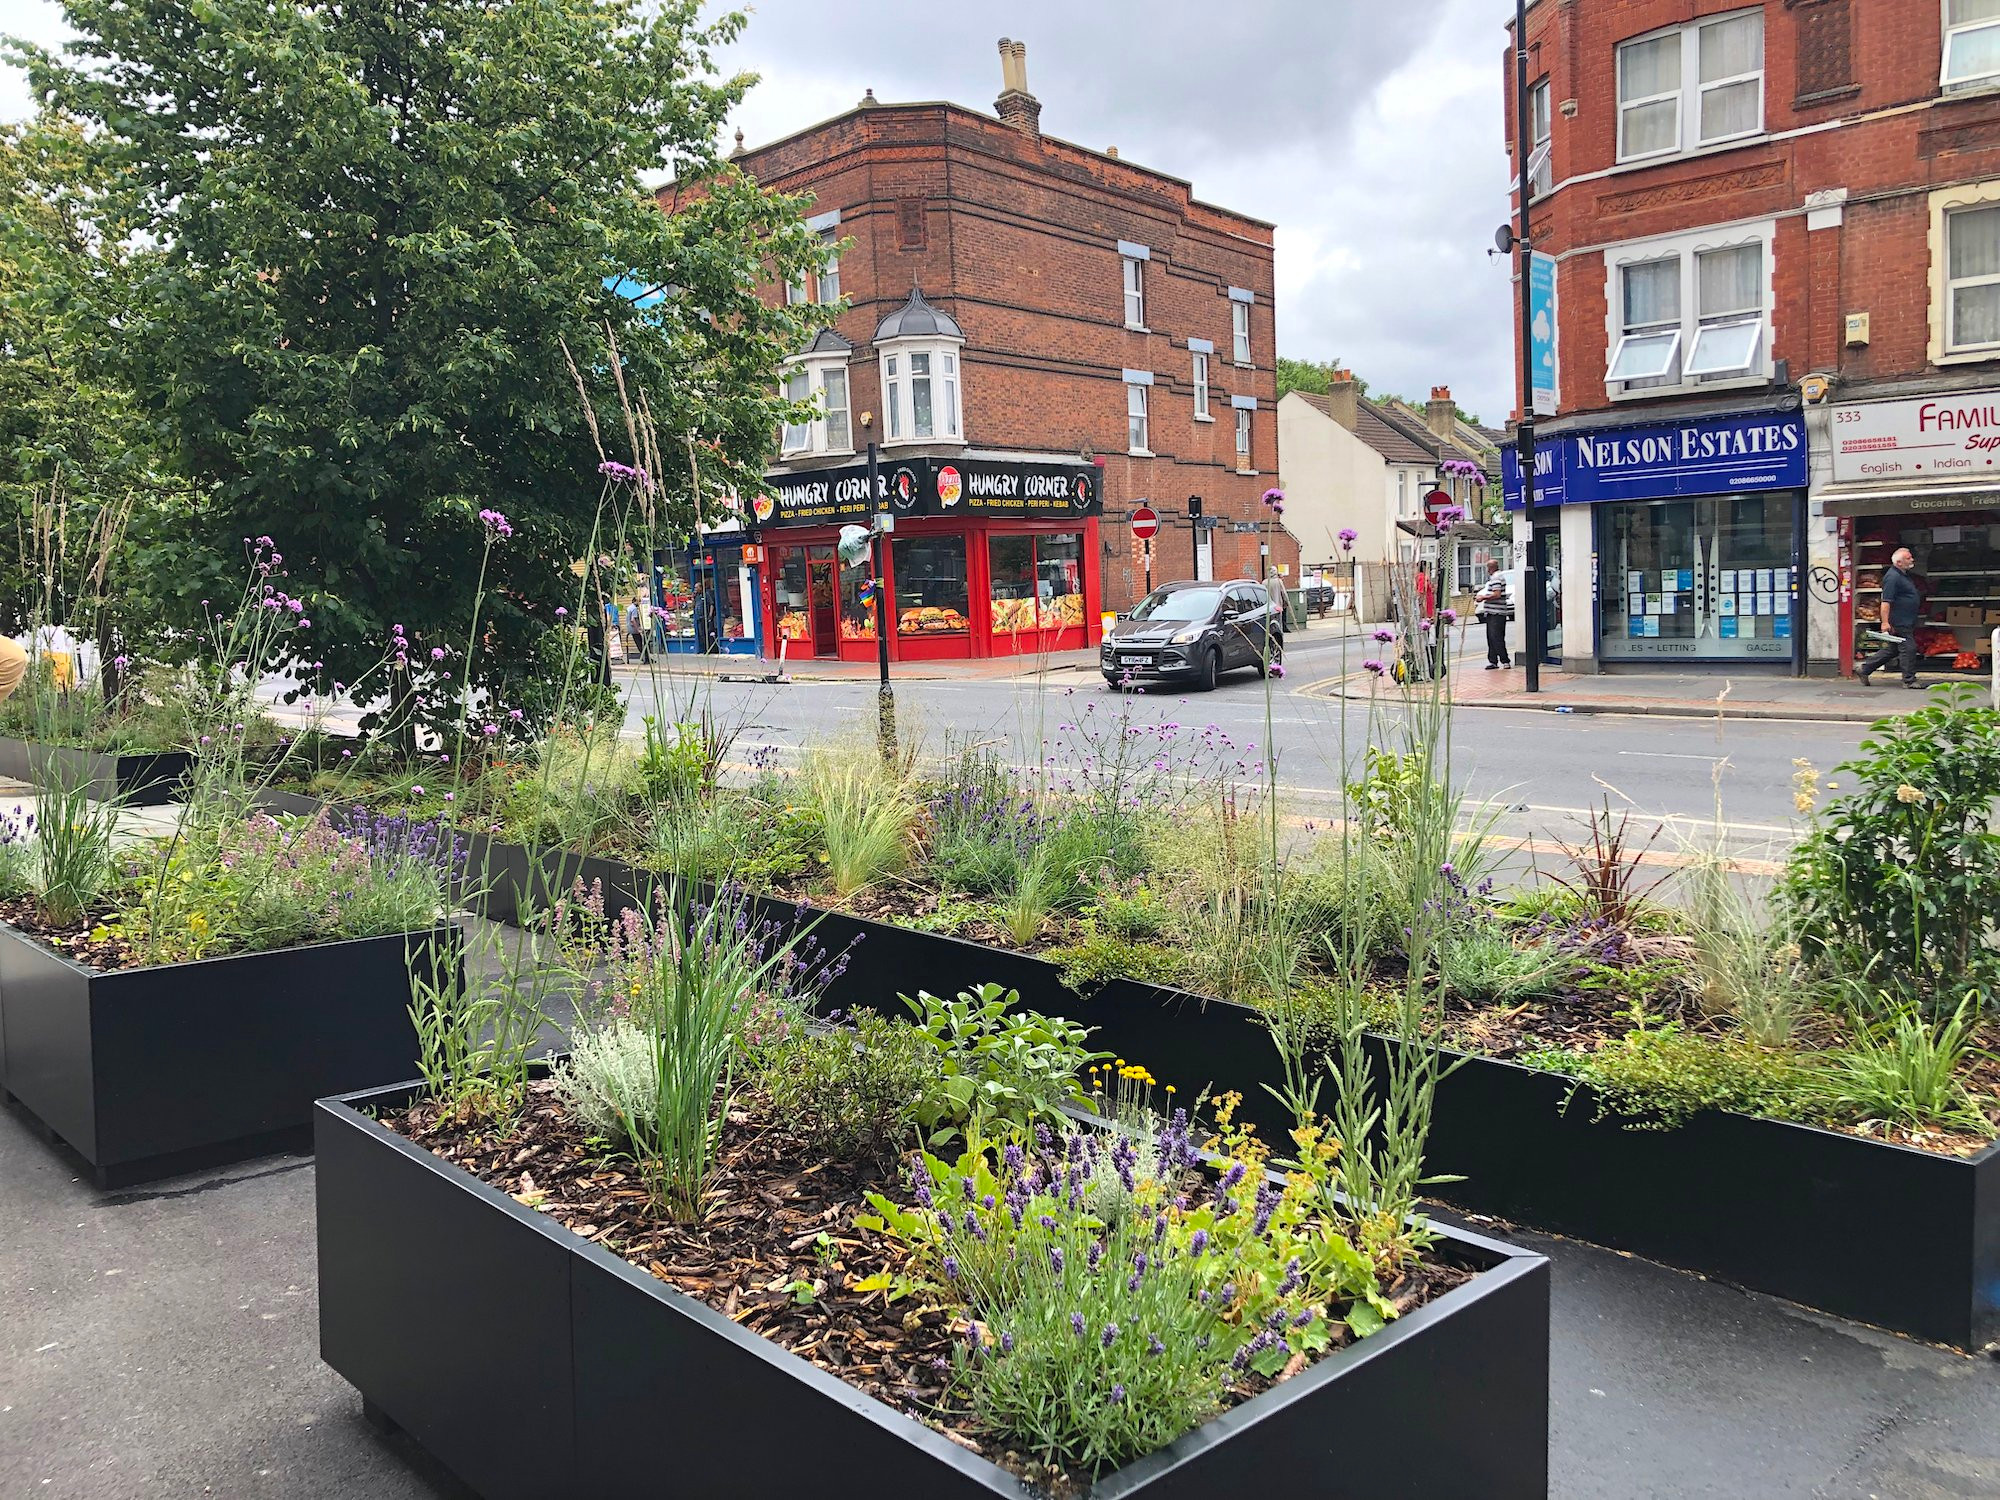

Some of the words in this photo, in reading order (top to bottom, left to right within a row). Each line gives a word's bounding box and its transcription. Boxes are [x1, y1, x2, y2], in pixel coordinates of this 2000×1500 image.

[1836, 411, 1861, 424] 333
[1576, 435, 1673, 469] NELSON
[1680, 423, 1799, 460] ESTATES
[1515, 450, 1552, 479] NSON
[1861, 462, 1902, 475] English
[1934, 458, 1971, 468] Indian
[779, 481, 829, 508] HUNGRY
[834, 475, 888, 502] CORNR
[968, 473, 1019, 496] HUNGRY
[1024, 475, 1069, 498] CORNER
[780, 511, 795, 519] PIZZA
[798, 509, 813, 517] FRIED
[813, 506, 835, 516] CHICKEN
[839, 505, 852, 513] PERI
[853, 503, 865, 512] PERI
[969, 499, 983, 507] PIZZA
[986, 499, 1001, 508] FRIED
[1002, 499, 1024, 508] CHICKEN
[1028, 500, 1039, 508] PERI
[1039, 500, 1050, 508] PERI
[1053, 500, 1069, 508] KEBAB
[1911, 499, 1966, 509] Groceries,
[1657, 644, 1696, 652] LETTING
